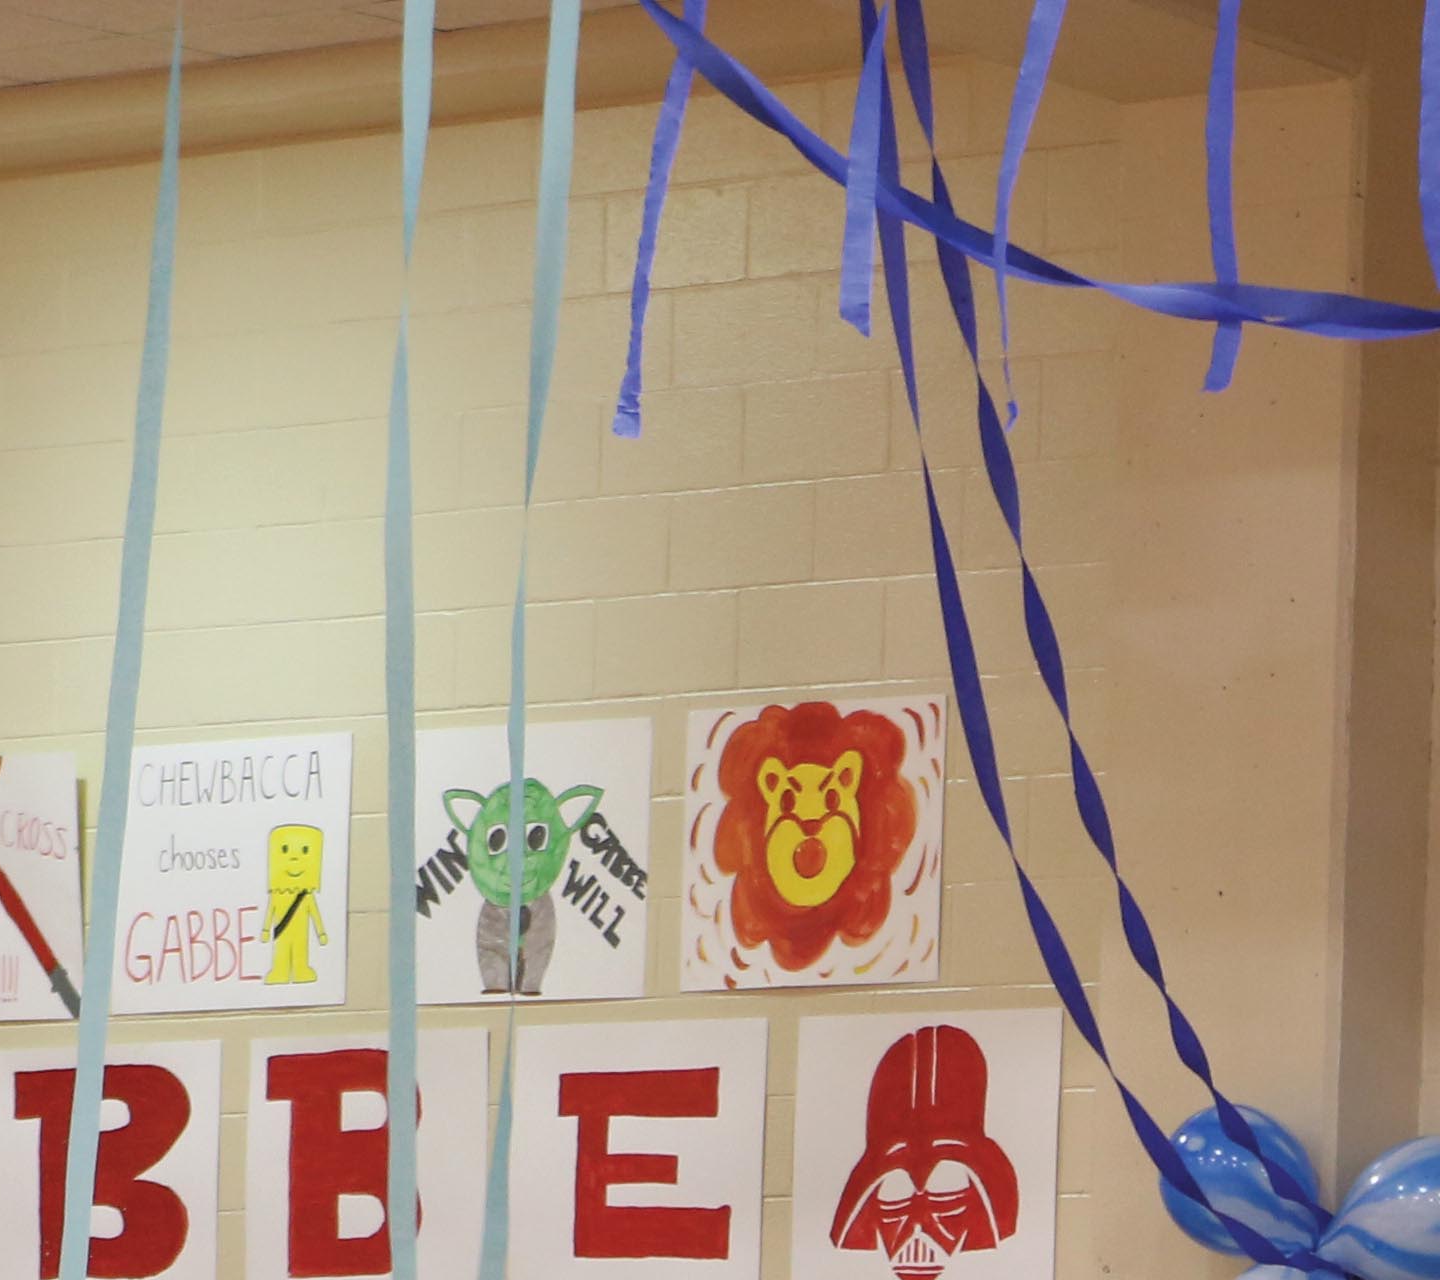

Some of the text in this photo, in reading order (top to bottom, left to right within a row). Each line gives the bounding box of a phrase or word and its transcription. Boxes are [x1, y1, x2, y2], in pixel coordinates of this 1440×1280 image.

[138, 750, 324, 807] CHEWBACCA
[0, 808, 68, 862] CROSS
[158, 834, 241, 873] chooses
[124, 903, 264, 984] GABBE
